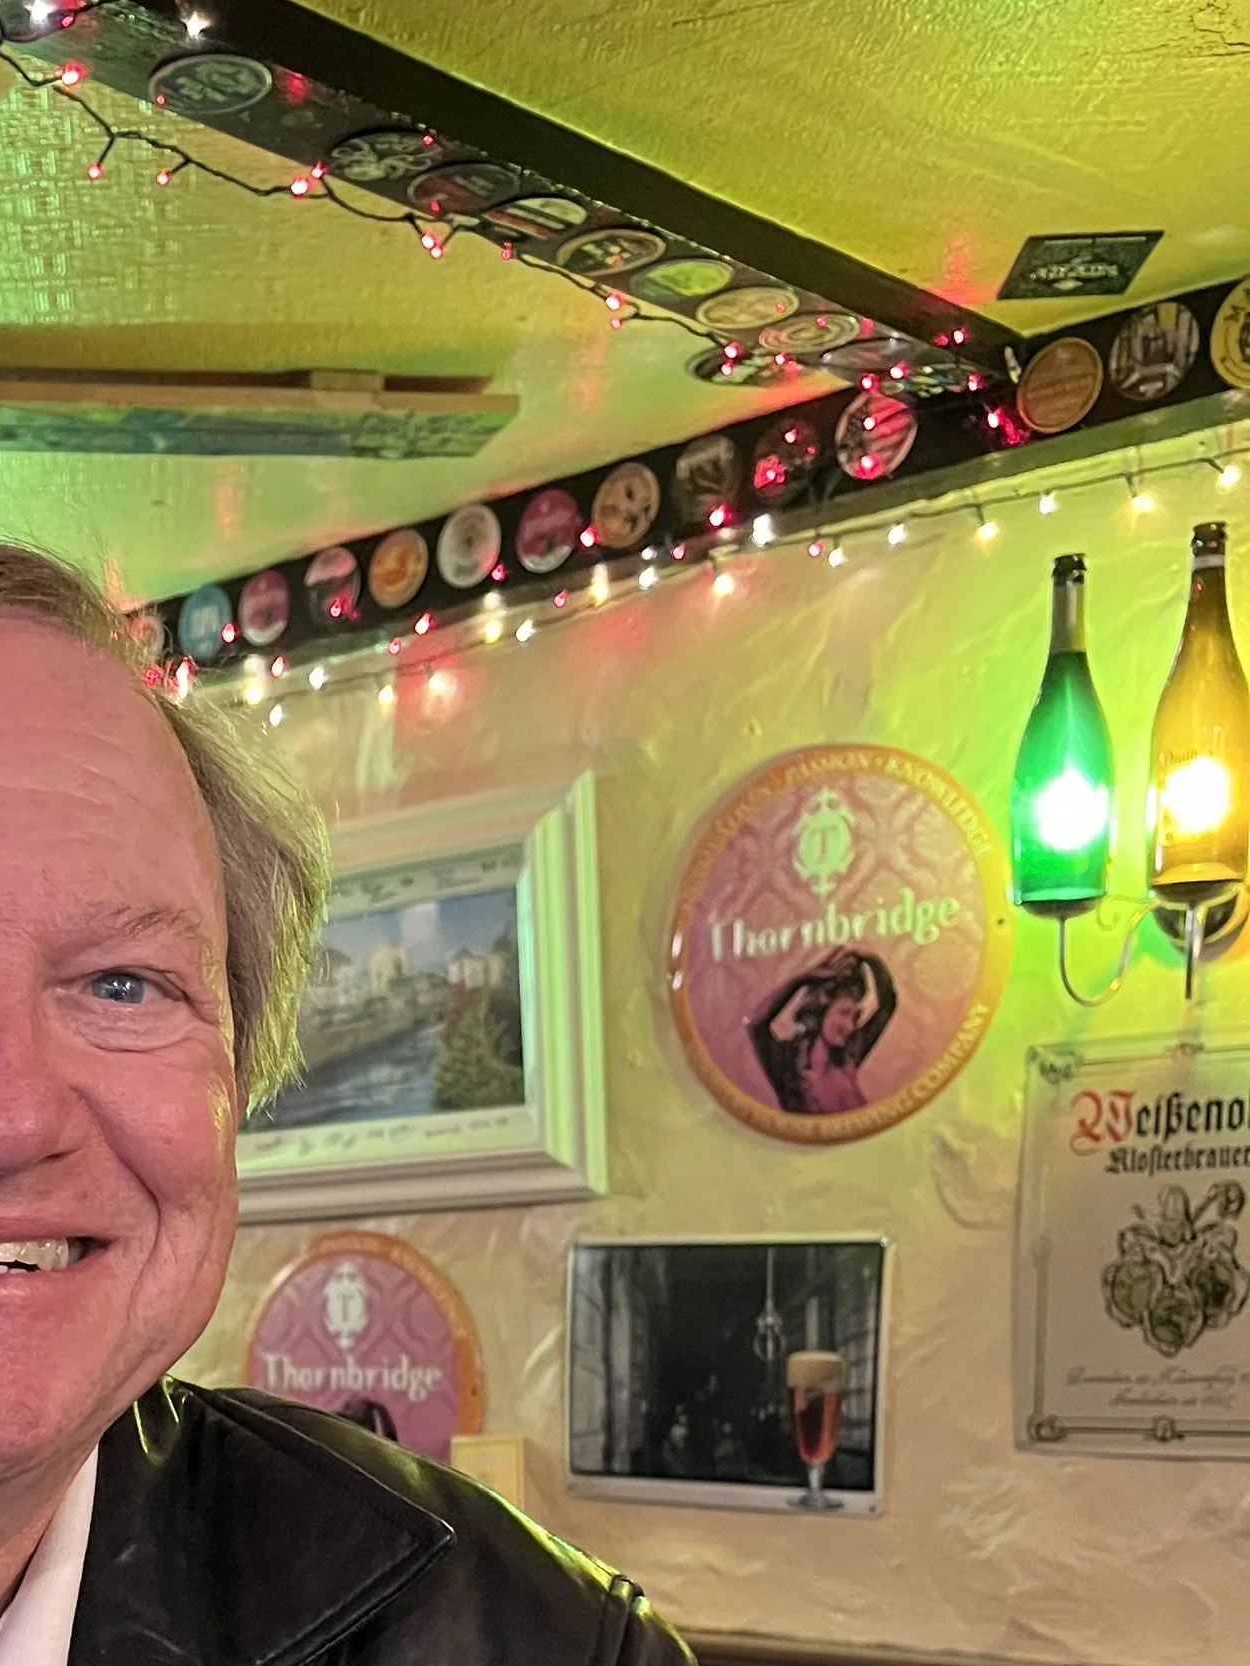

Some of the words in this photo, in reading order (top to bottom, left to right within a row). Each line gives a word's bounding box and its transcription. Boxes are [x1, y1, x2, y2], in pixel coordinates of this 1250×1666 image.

[707, 885, 961, 963] Thornbridge
[1068, 1089, 1250, 1157] Weißeno
[262, 1351, 443, 1403] Thornbridge
